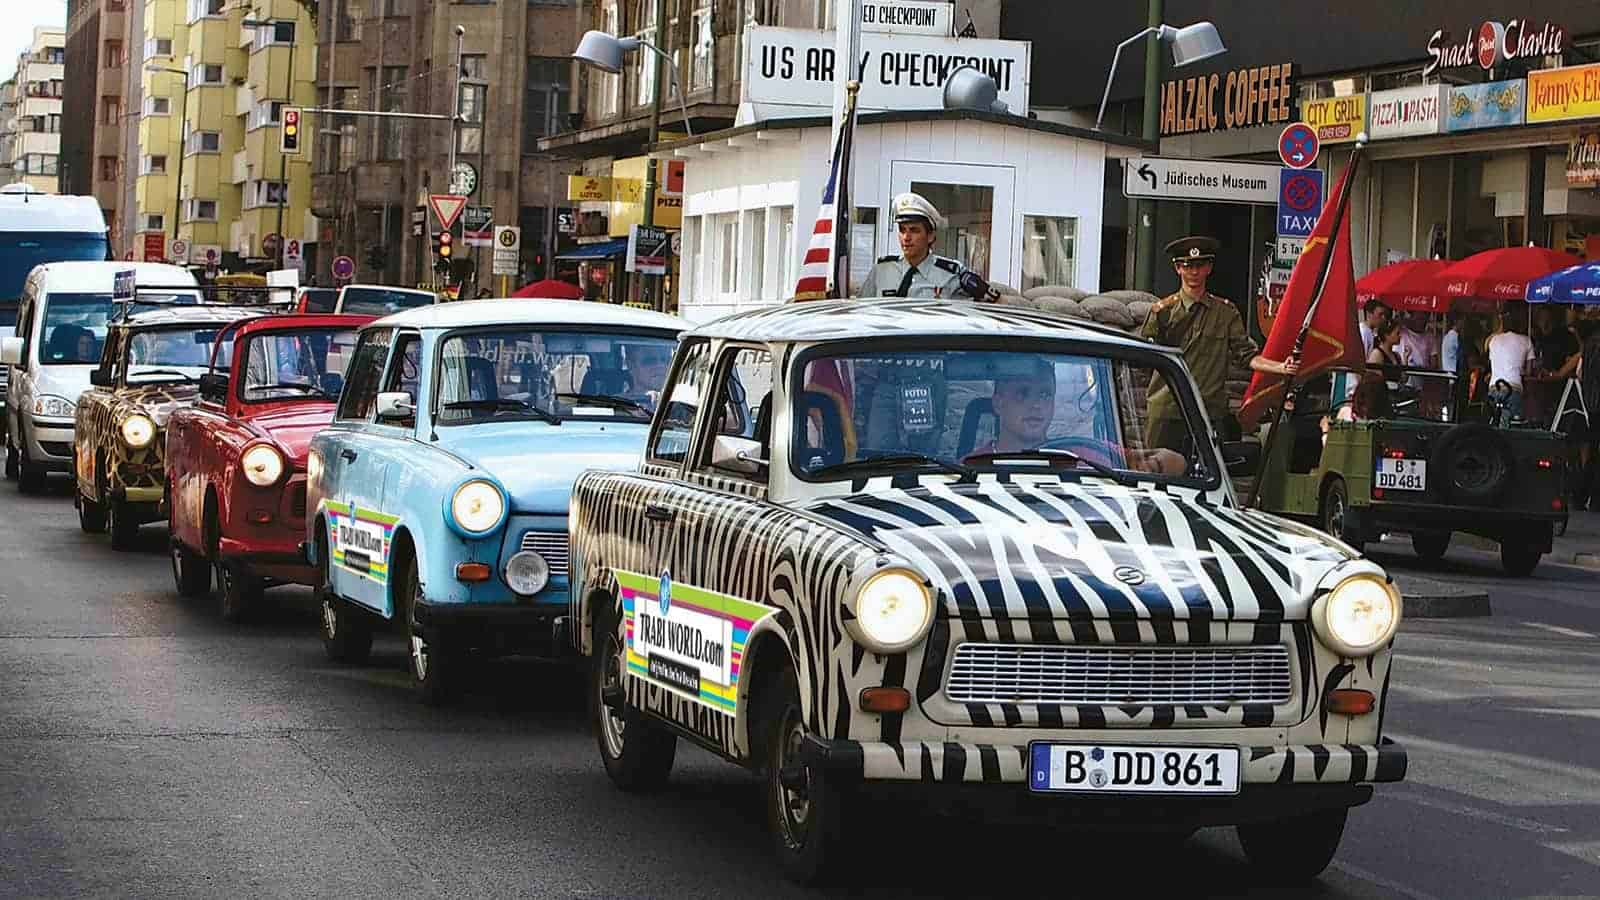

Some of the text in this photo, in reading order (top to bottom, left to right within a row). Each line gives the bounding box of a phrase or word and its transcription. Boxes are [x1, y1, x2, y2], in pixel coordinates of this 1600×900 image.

[879, 6, 936, 27] CHECKPOINT
[1422, 28, 1474, 77] Snack
[1502, 18, 1563, 60] Charlie
[762, 45, 1015, 92] US ARY CHECKINT
[1160, 63, 1292, 135] ALZAC COFFEE
[1531, 77, 1580, 113] Janny's
[1583, 69, 1600, 102] Ei
[1308, 99, 1362, 126] CITY GRILL
[1371, 102, 1398, 127] PIZZA
[1408, 96, 1438, 123] PASTA
[1164, 170, 1267, 190] Jüdisches Museum
[1282, 215, 1317, 231] TAXI
[1380, 473, 1422, 489] DD 481
[1395, 460, 1404, 473] B
[640, 611, 723, 669] TRABI WORLD.com
[1037, 772, 1045, 782] D
[1065, 750, 1223, 787] B DD 861
